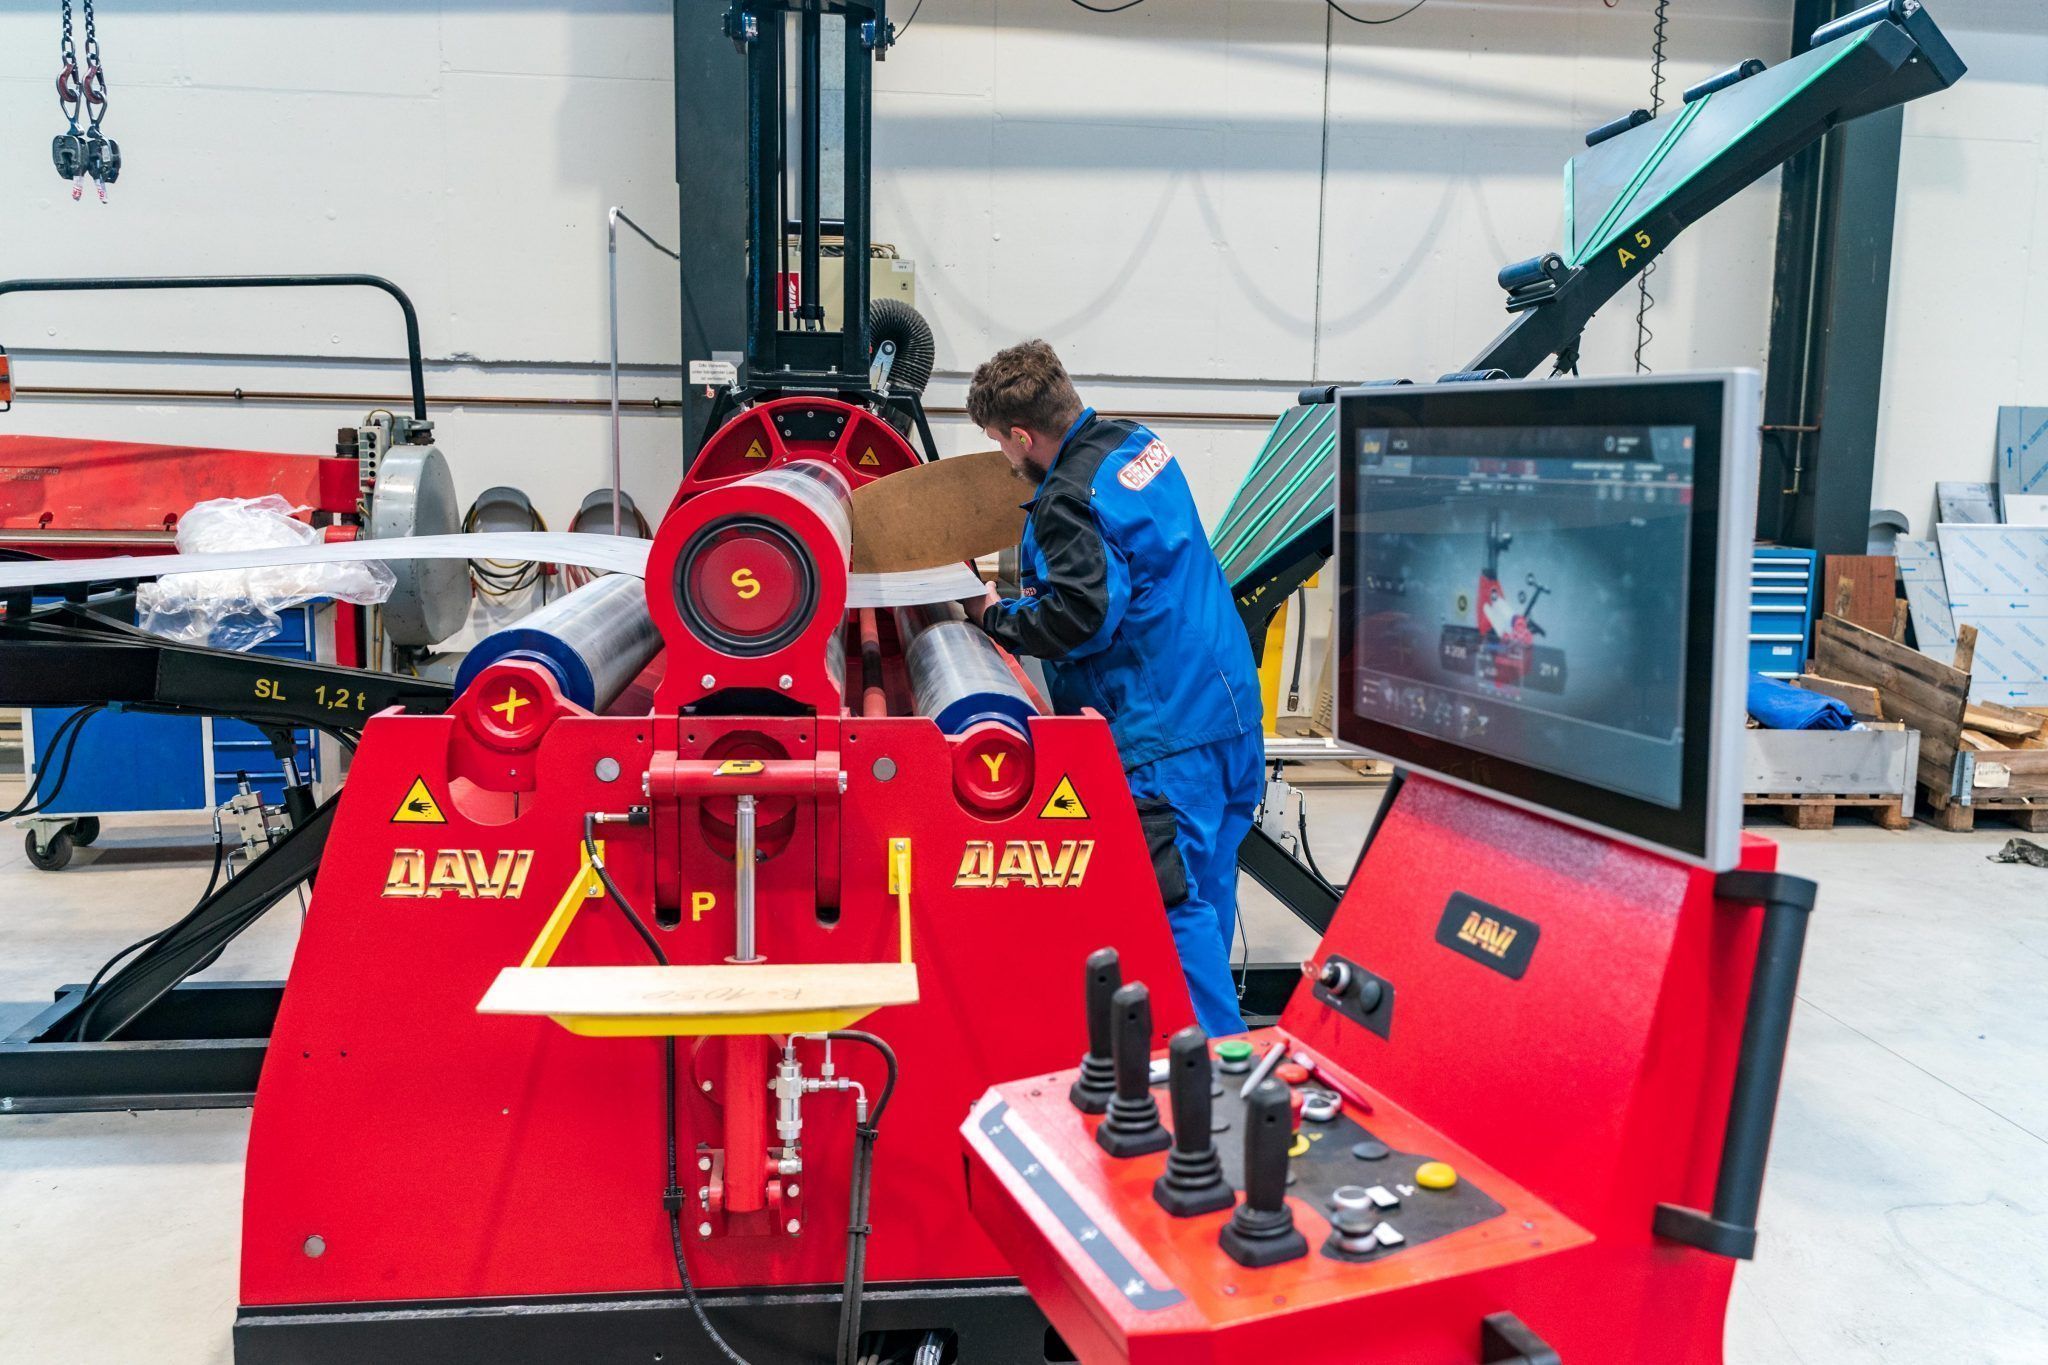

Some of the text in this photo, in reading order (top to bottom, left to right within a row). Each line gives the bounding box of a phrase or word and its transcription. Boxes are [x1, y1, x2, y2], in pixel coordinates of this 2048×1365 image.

[1617, 229, 1651, 269] A 5
[731, 568, 761, 599] S
[254, 678, 366, 711] SL 1,2 t
[490, 686, 531, 725] X
[980, 752, 1007, 782] Y
[380, 847, 535, 900] DAVI
[952, 839, 1096, 889] DAVI
[691, 891, 717, 922] P
[1456, 910, 1518, 959] DAVI
